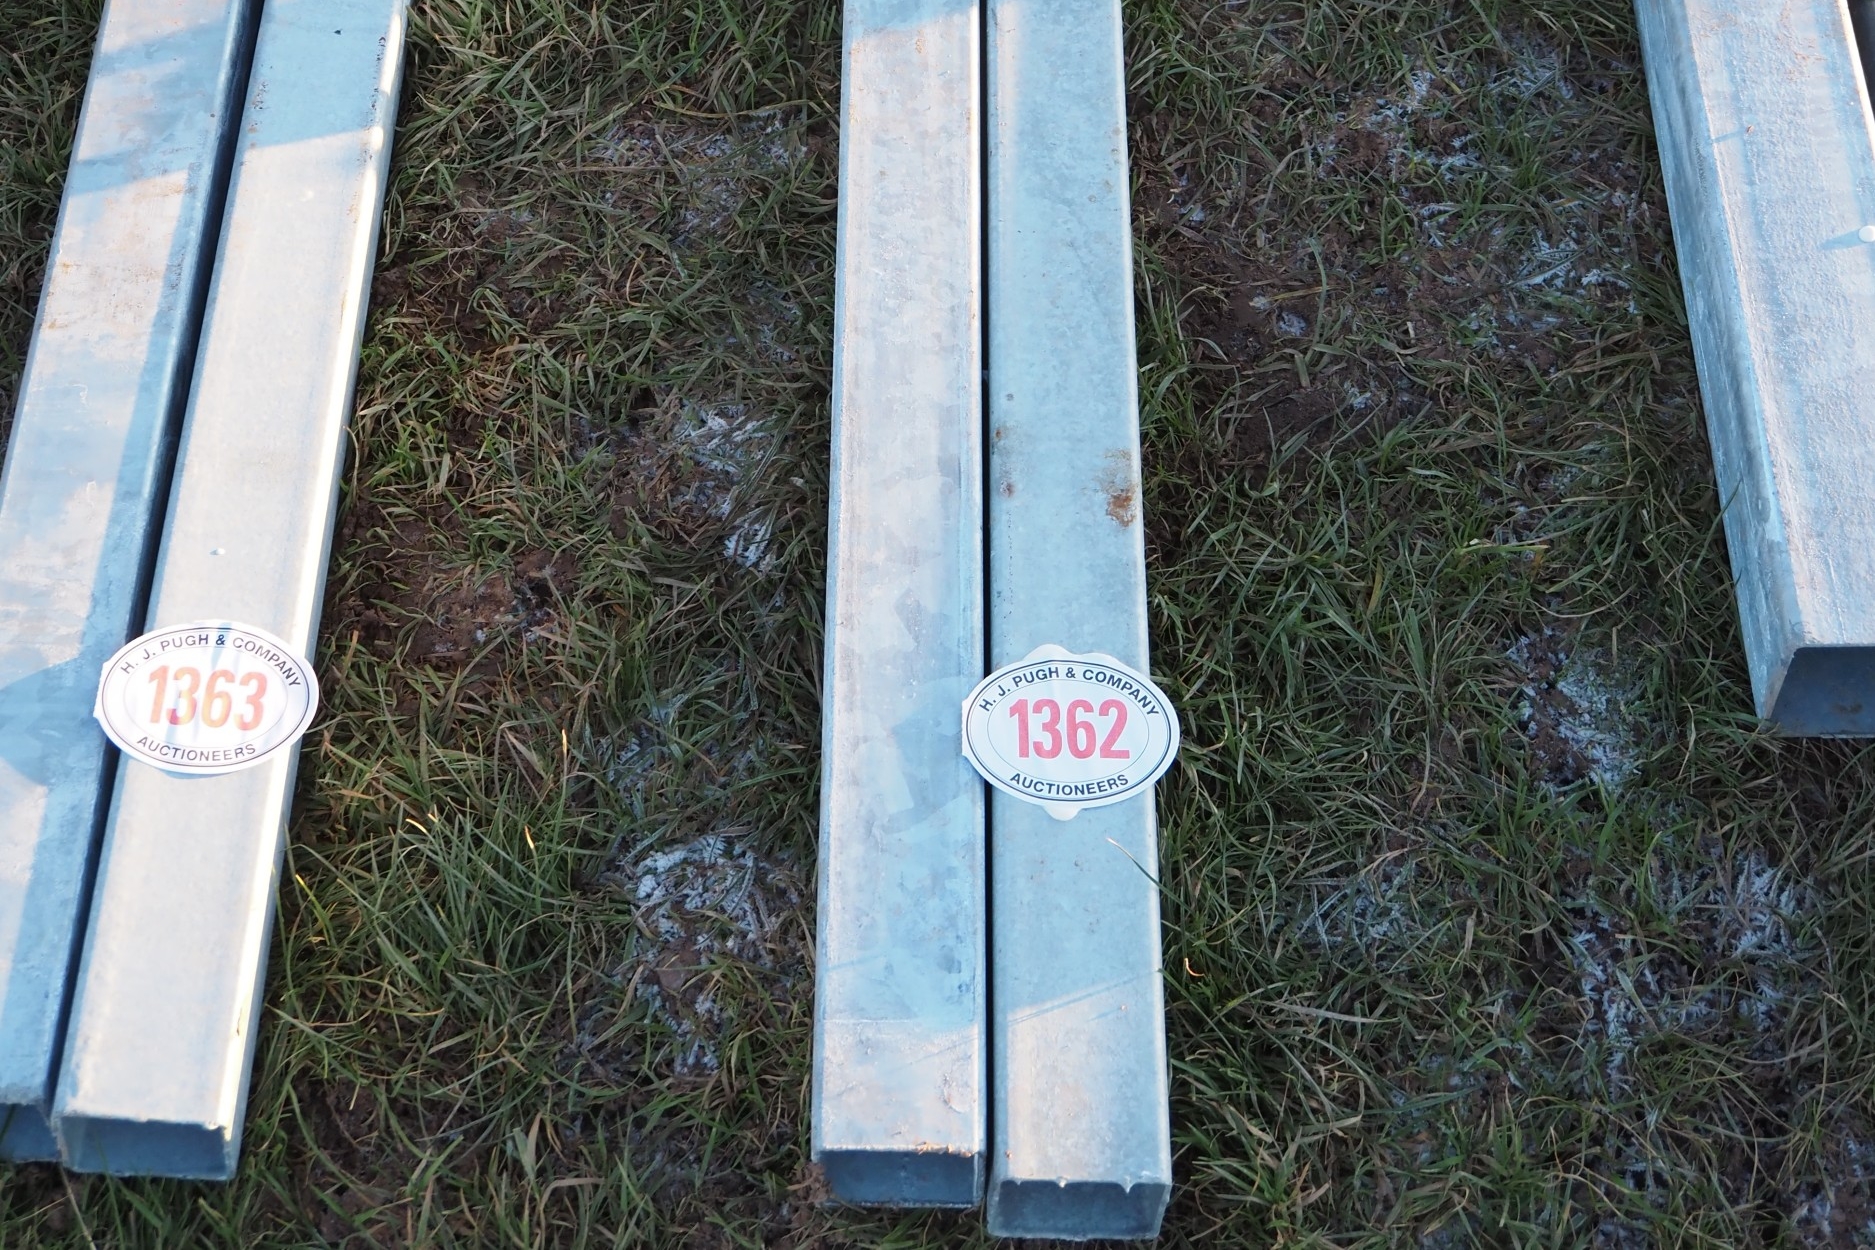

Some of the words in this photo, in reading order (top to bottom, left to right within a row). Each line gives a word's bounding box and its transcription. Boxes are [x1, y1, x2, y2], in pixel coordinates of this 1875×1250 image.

[121, 662, 139, 674] H.
[143, 648, 156, 660] J.
[160, 634, 209, 651] PUGH
[215, 634, 225, 645] &
[233, 637, 301, 687] COMPANY
[148, 665, 267, 731] 1363
[979, 698, 996, 712] H.
[998, 684, 1011, 697] J.
[1012, 667, 1059, 687] PUGH
[1066, 667, 1076, 679] &
[1083, 669, 1159, 717] COMPANY
[137, 736, 256, 761] AUCTIONEERS
[1009, 699, 1130, 759] 1362
[1010, 773, 1129, 795] AUCTIONEERS
